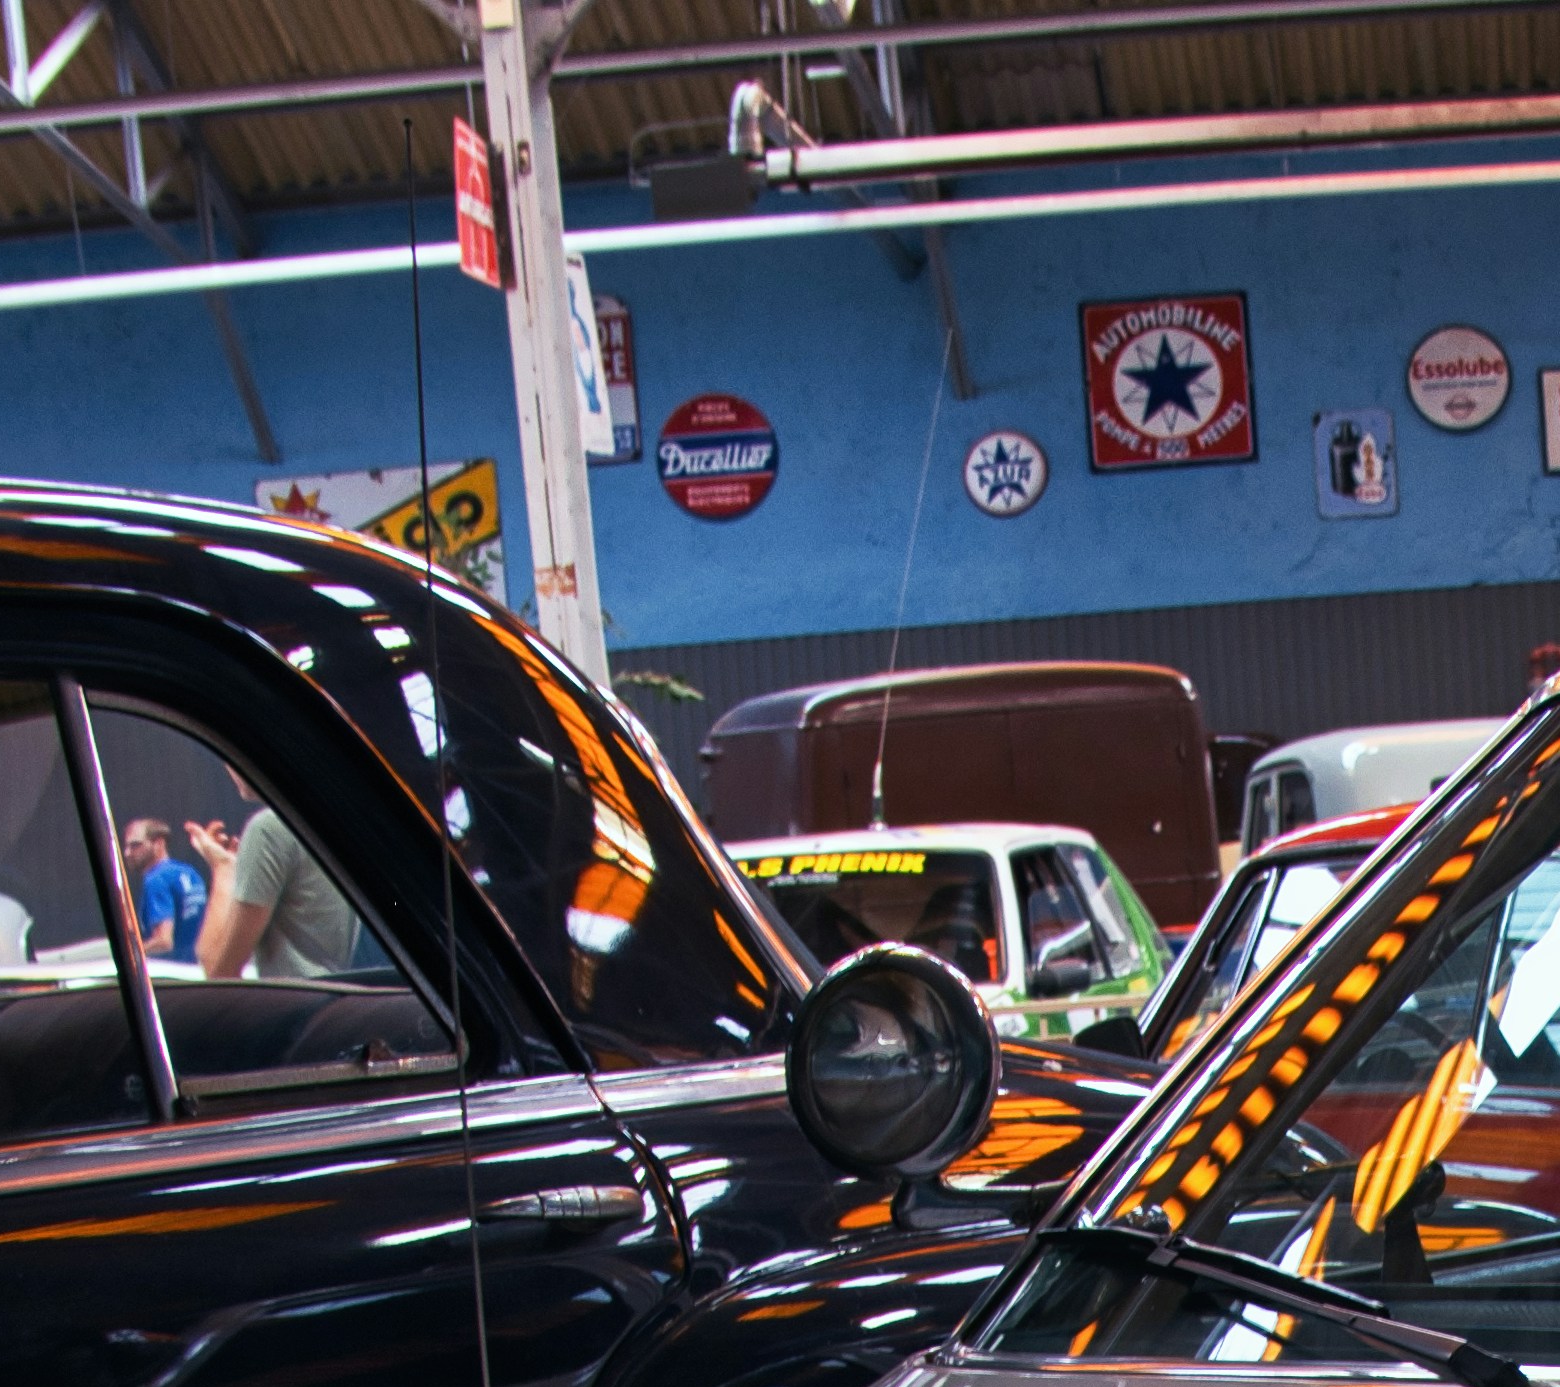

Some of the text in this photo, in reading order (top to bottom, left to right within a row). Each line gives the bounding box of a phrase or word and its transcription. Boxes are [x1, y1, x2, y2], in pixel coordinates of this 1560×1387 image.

[1092, 303, 1242, 364] AUTOMOBILINE
[1411, 355, 1506, 381] Essolube
[659, 441, 773, 478] Ducellier
